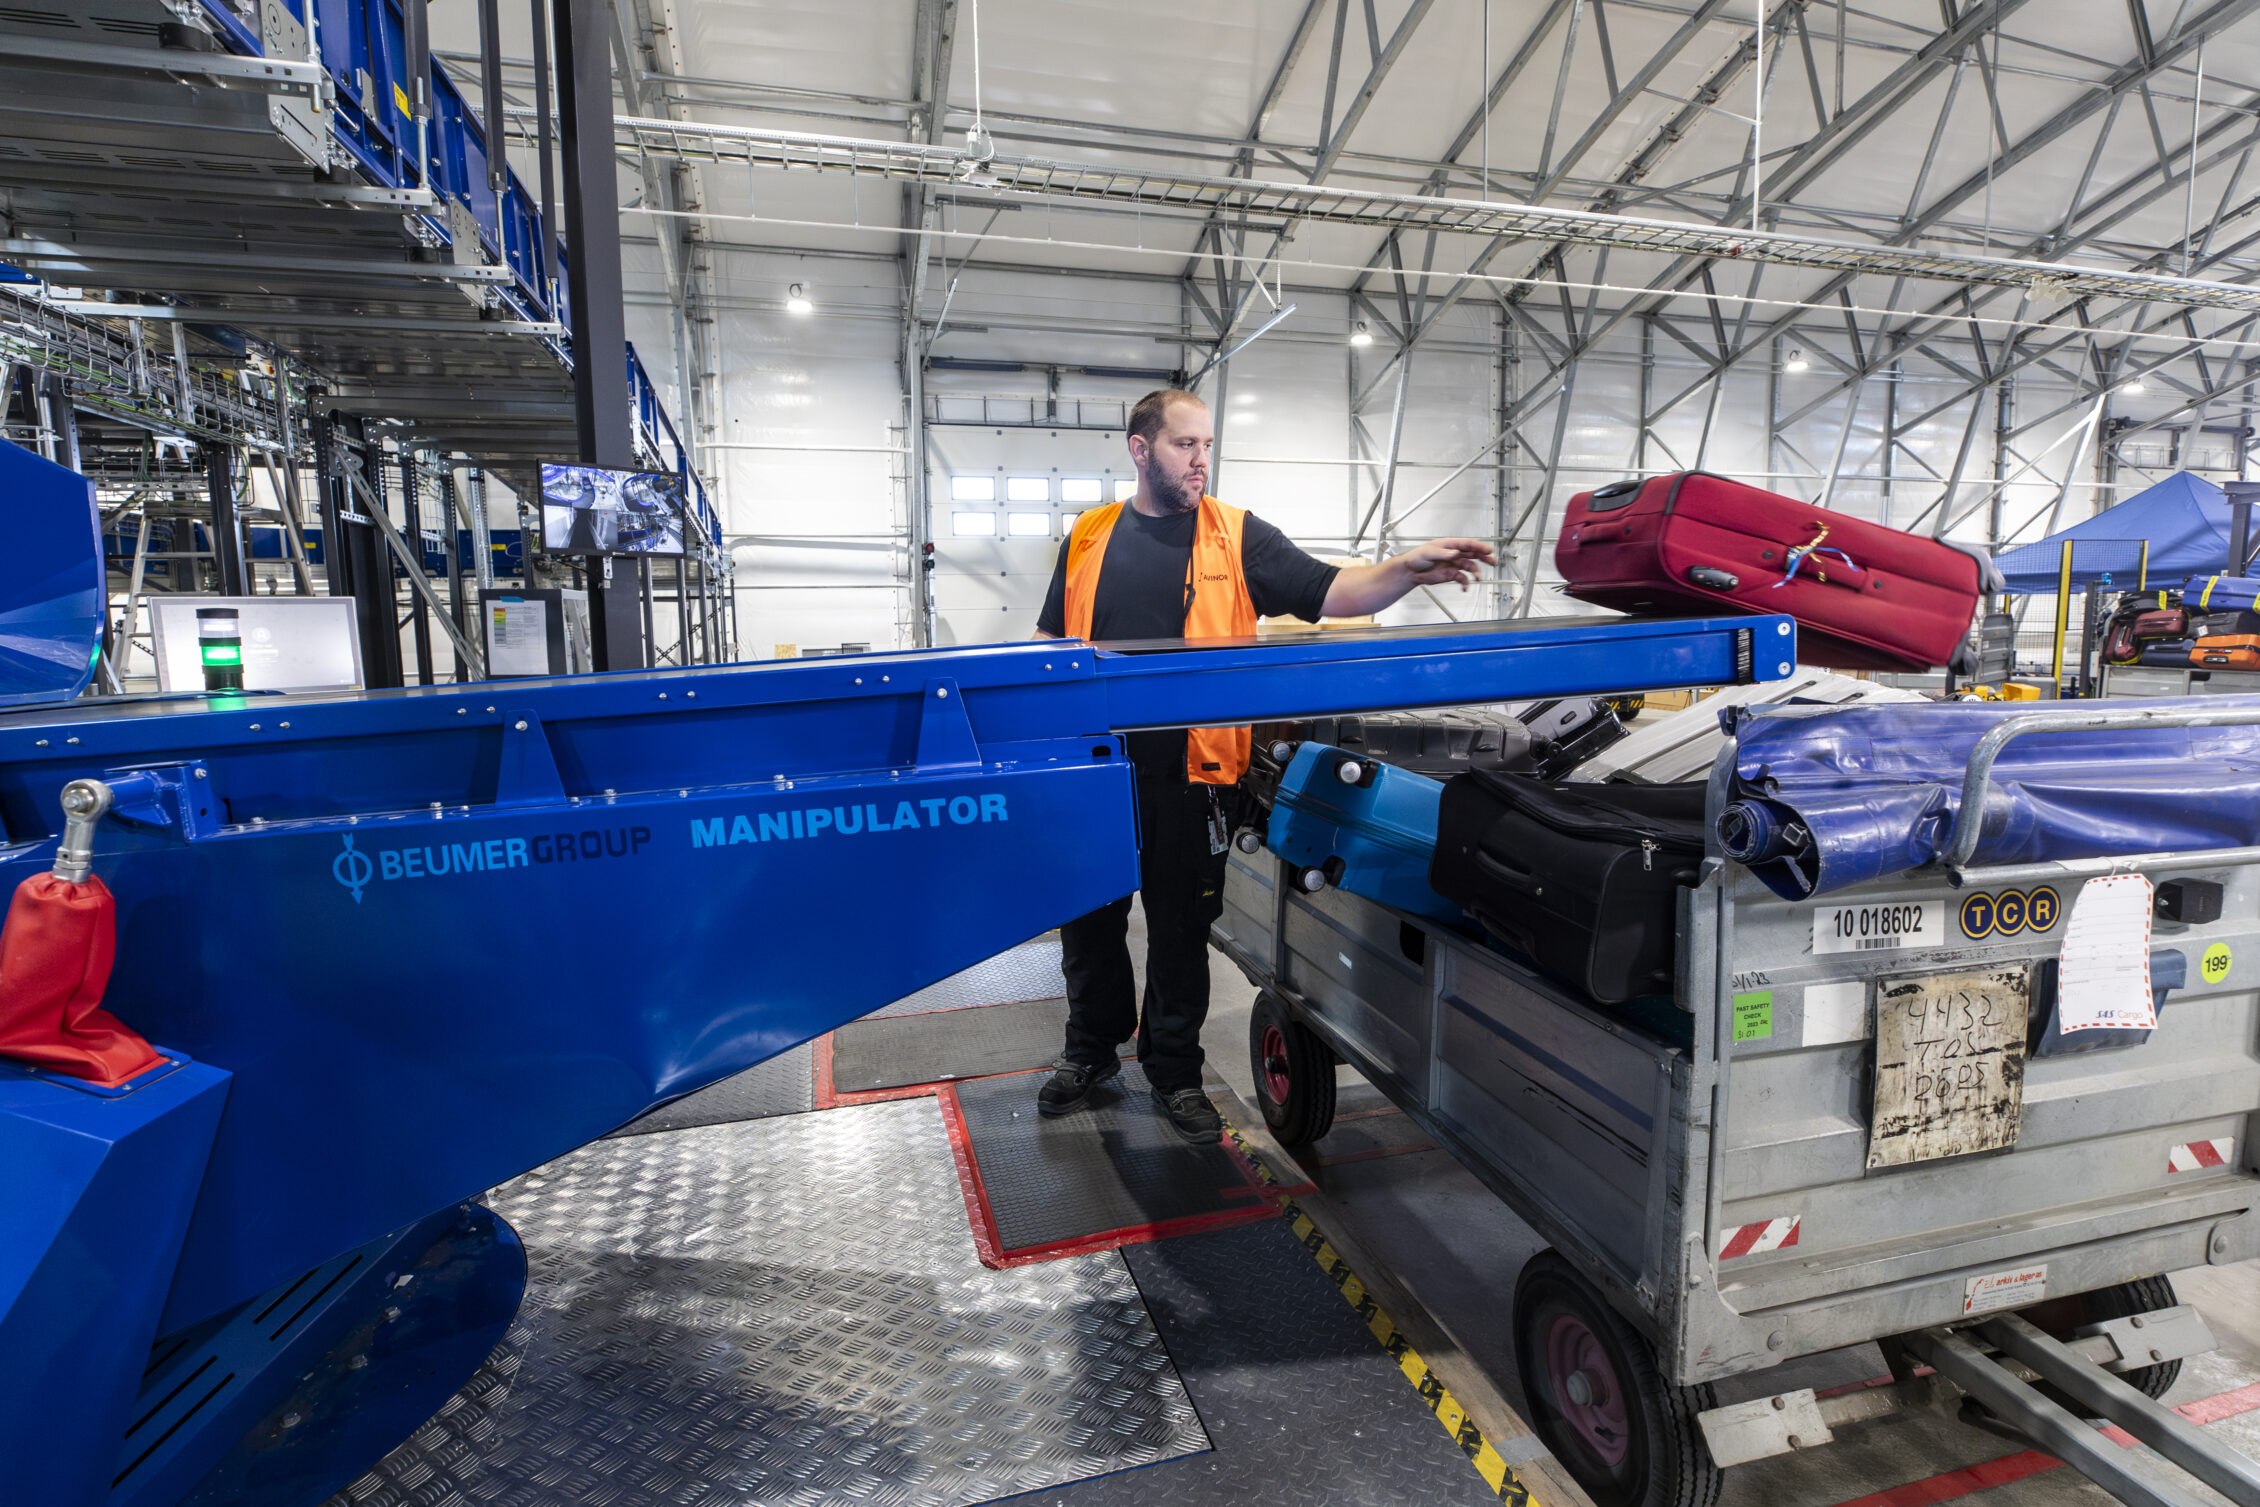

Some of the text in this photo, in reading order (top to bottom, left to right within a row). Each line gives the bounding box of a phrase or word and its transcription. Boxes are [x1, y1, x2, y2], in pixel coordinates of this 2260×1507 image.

[690, 793, 1008, 848] MANIPULATOR
[1833, 905, 1923, 938] 10 018602
[1971, 899, 2050, 927] TCR
[2205, 955, 2228, 973] 199
[1750, 1002, 1769, 1010] SAFETY
[1908, 992, 2003, 1034] 4432
[2096, 1010, 2143, 1020] SAS Cargo
